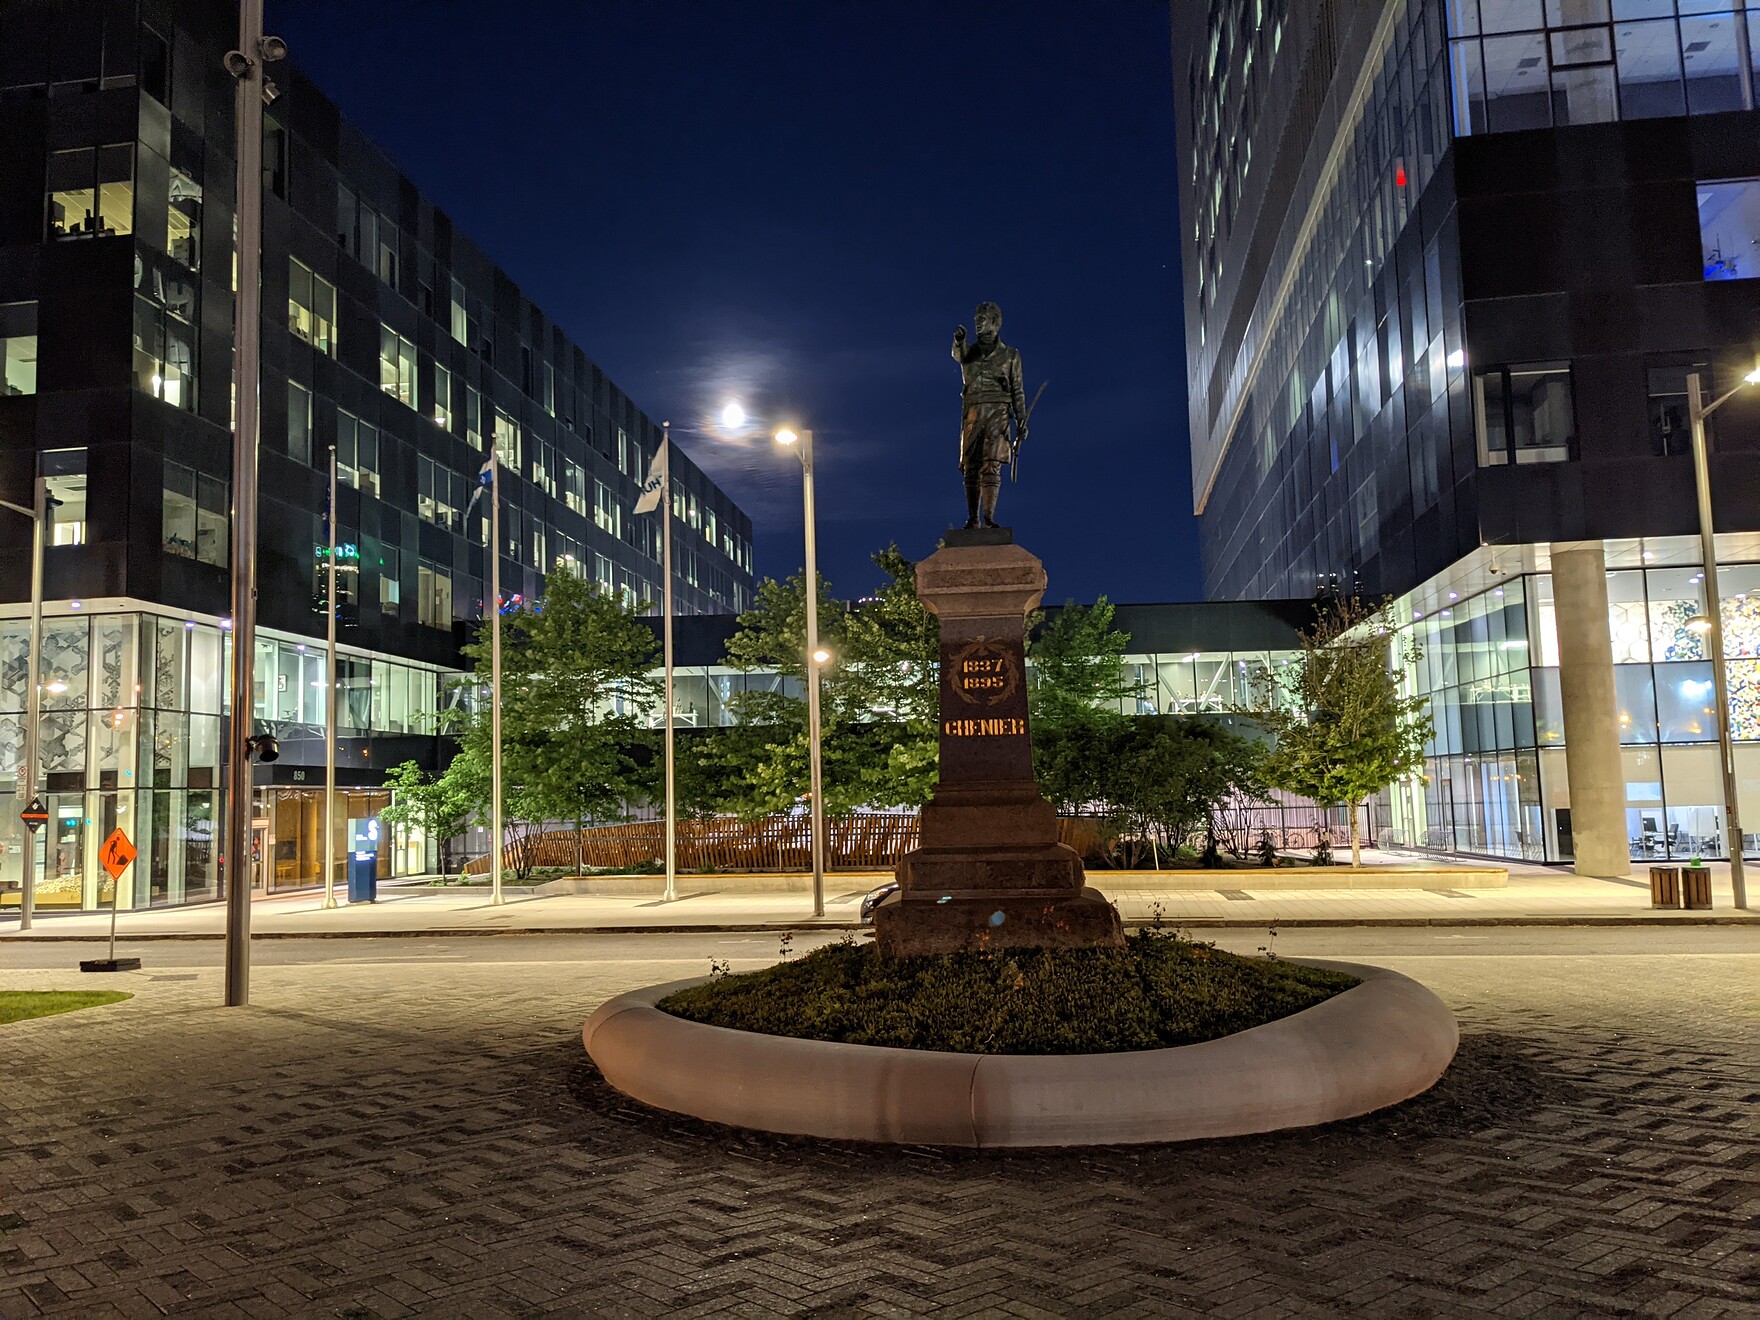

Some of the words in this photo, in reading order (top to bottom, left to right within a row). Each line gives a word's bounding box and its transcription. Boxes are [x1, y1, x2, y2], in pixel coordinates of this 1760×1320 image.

[963, 659, 1003, 673] 1837
[964, 676, 1004, 689] 1895
[945, 718, 1025, 736] CHENIER
[293, 770, 305, 780] 850
